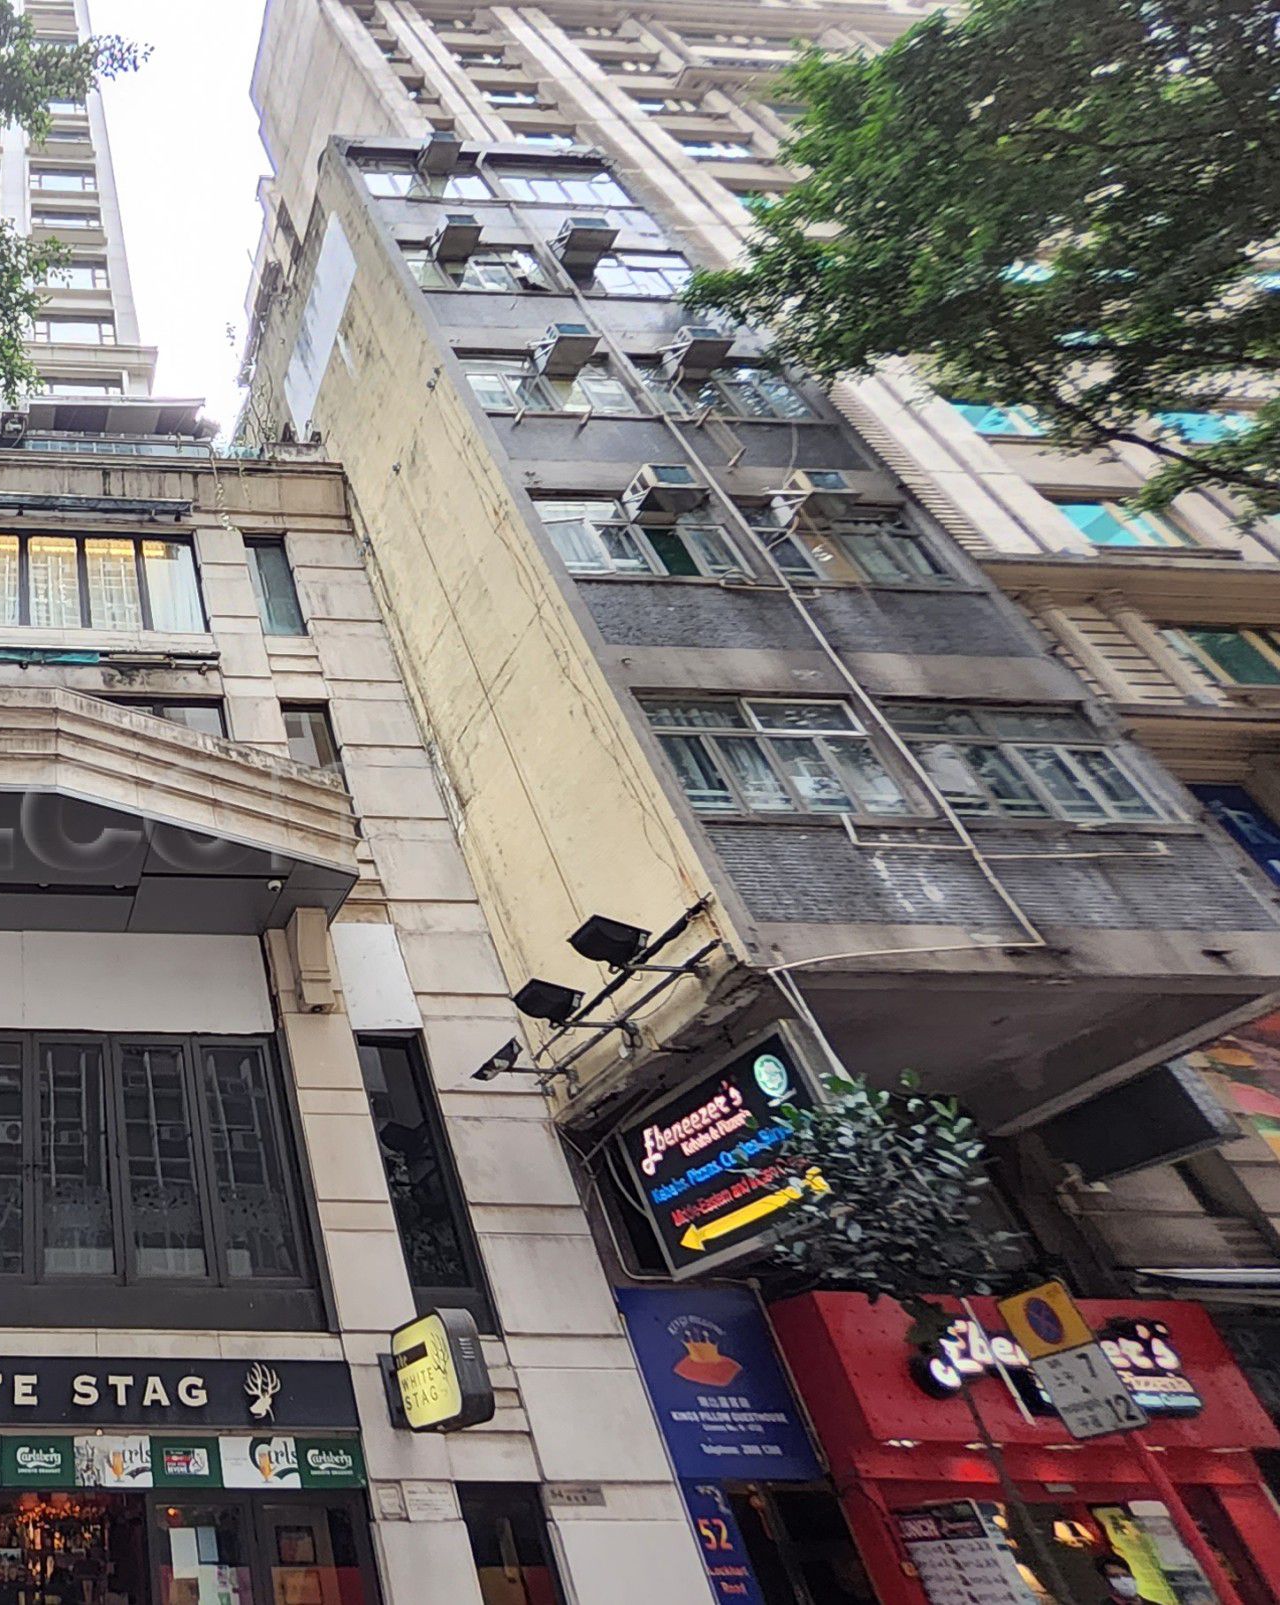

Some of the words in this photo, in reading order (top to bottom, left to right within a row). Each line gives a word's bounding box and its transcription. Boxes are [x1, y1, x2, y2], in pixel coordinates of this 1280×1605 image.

[72, 1375, 208, 1407] STAG
[401, 1368, 435, 1391] WHITE
[405, 1386, 438, 1411] STAG
[17, 1446, 62, 1468] Carlsberg
[306, 1448, 353, 1469] Carlsberg
[698, 1518, 736, 1552] 52
